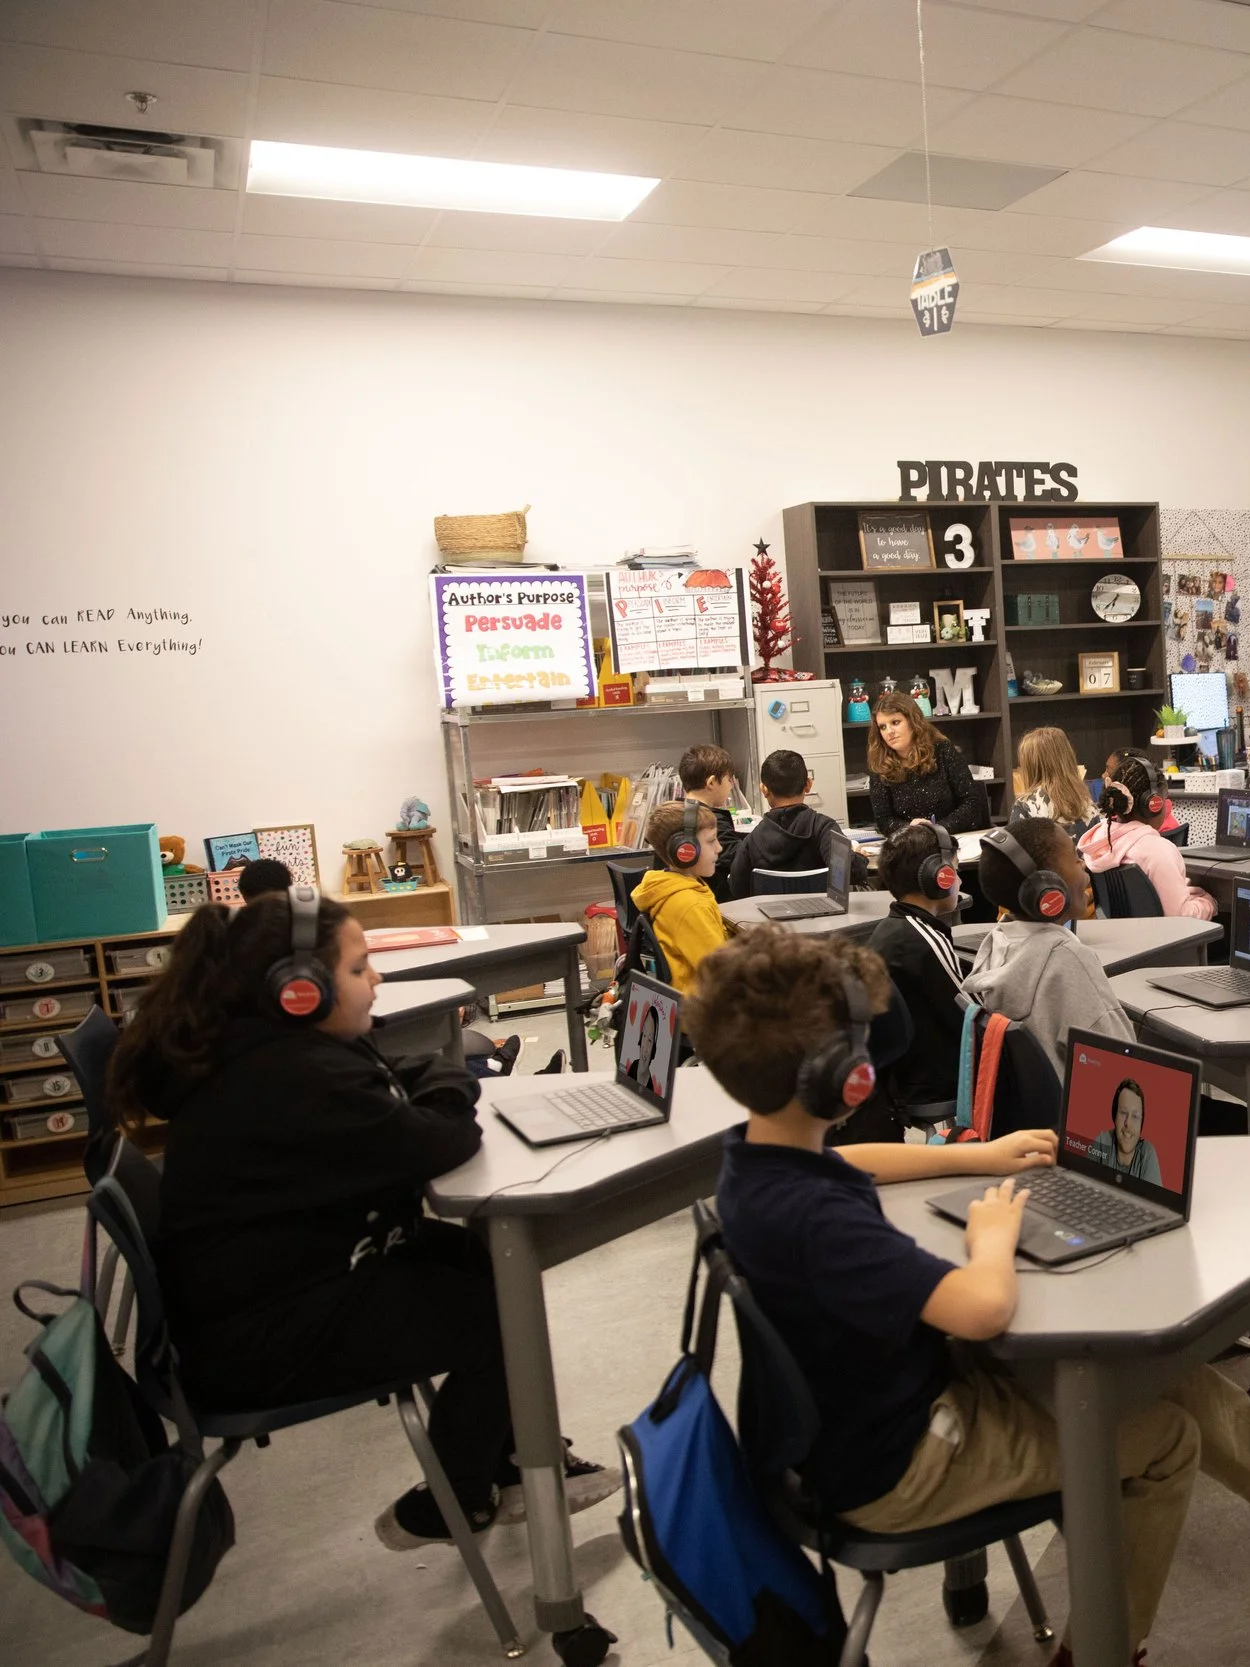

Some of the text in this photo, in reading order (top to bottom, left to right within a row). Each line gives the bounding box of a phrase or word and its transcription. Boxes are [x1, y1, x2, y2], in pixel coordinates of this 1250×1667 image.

[917, 286, 954, 311] TABLE
[933, 307, 938, 331] 1
[897, 461, 1079, 502] PIRATES
[888, 524, 907, 536] good
[877, 537, 910, 547] to have
[944, 523, 975, 569] 3
[872, 552, 880, 560] a
[881, 550, 901, 562] good
[448, 592, 574, 605] Author's Purpose
[618, 584, 661, 598] purpose
[2, 614, 30, 628] you
[42, 615, 68, 626] can
[77, 608, 115, 623] READ
[465, 612, 563, 633] Persuade
[963, 608, 990, 642] T
[0, 638, 203, 656] ou CAN LEARN Everything!
[476, 643, 555, 662] Inform
[467, 671, 571, 692] Entertain
[1089, 673, 1111, 685] 0 7
[929, 667, 980, 717] M
[273, 842, 300, 855] fun
[38, 968, 43, 977] 3
[53, 1081, 61, 1090] 15
[1065, 1136, 1087, 1152] Teacher
